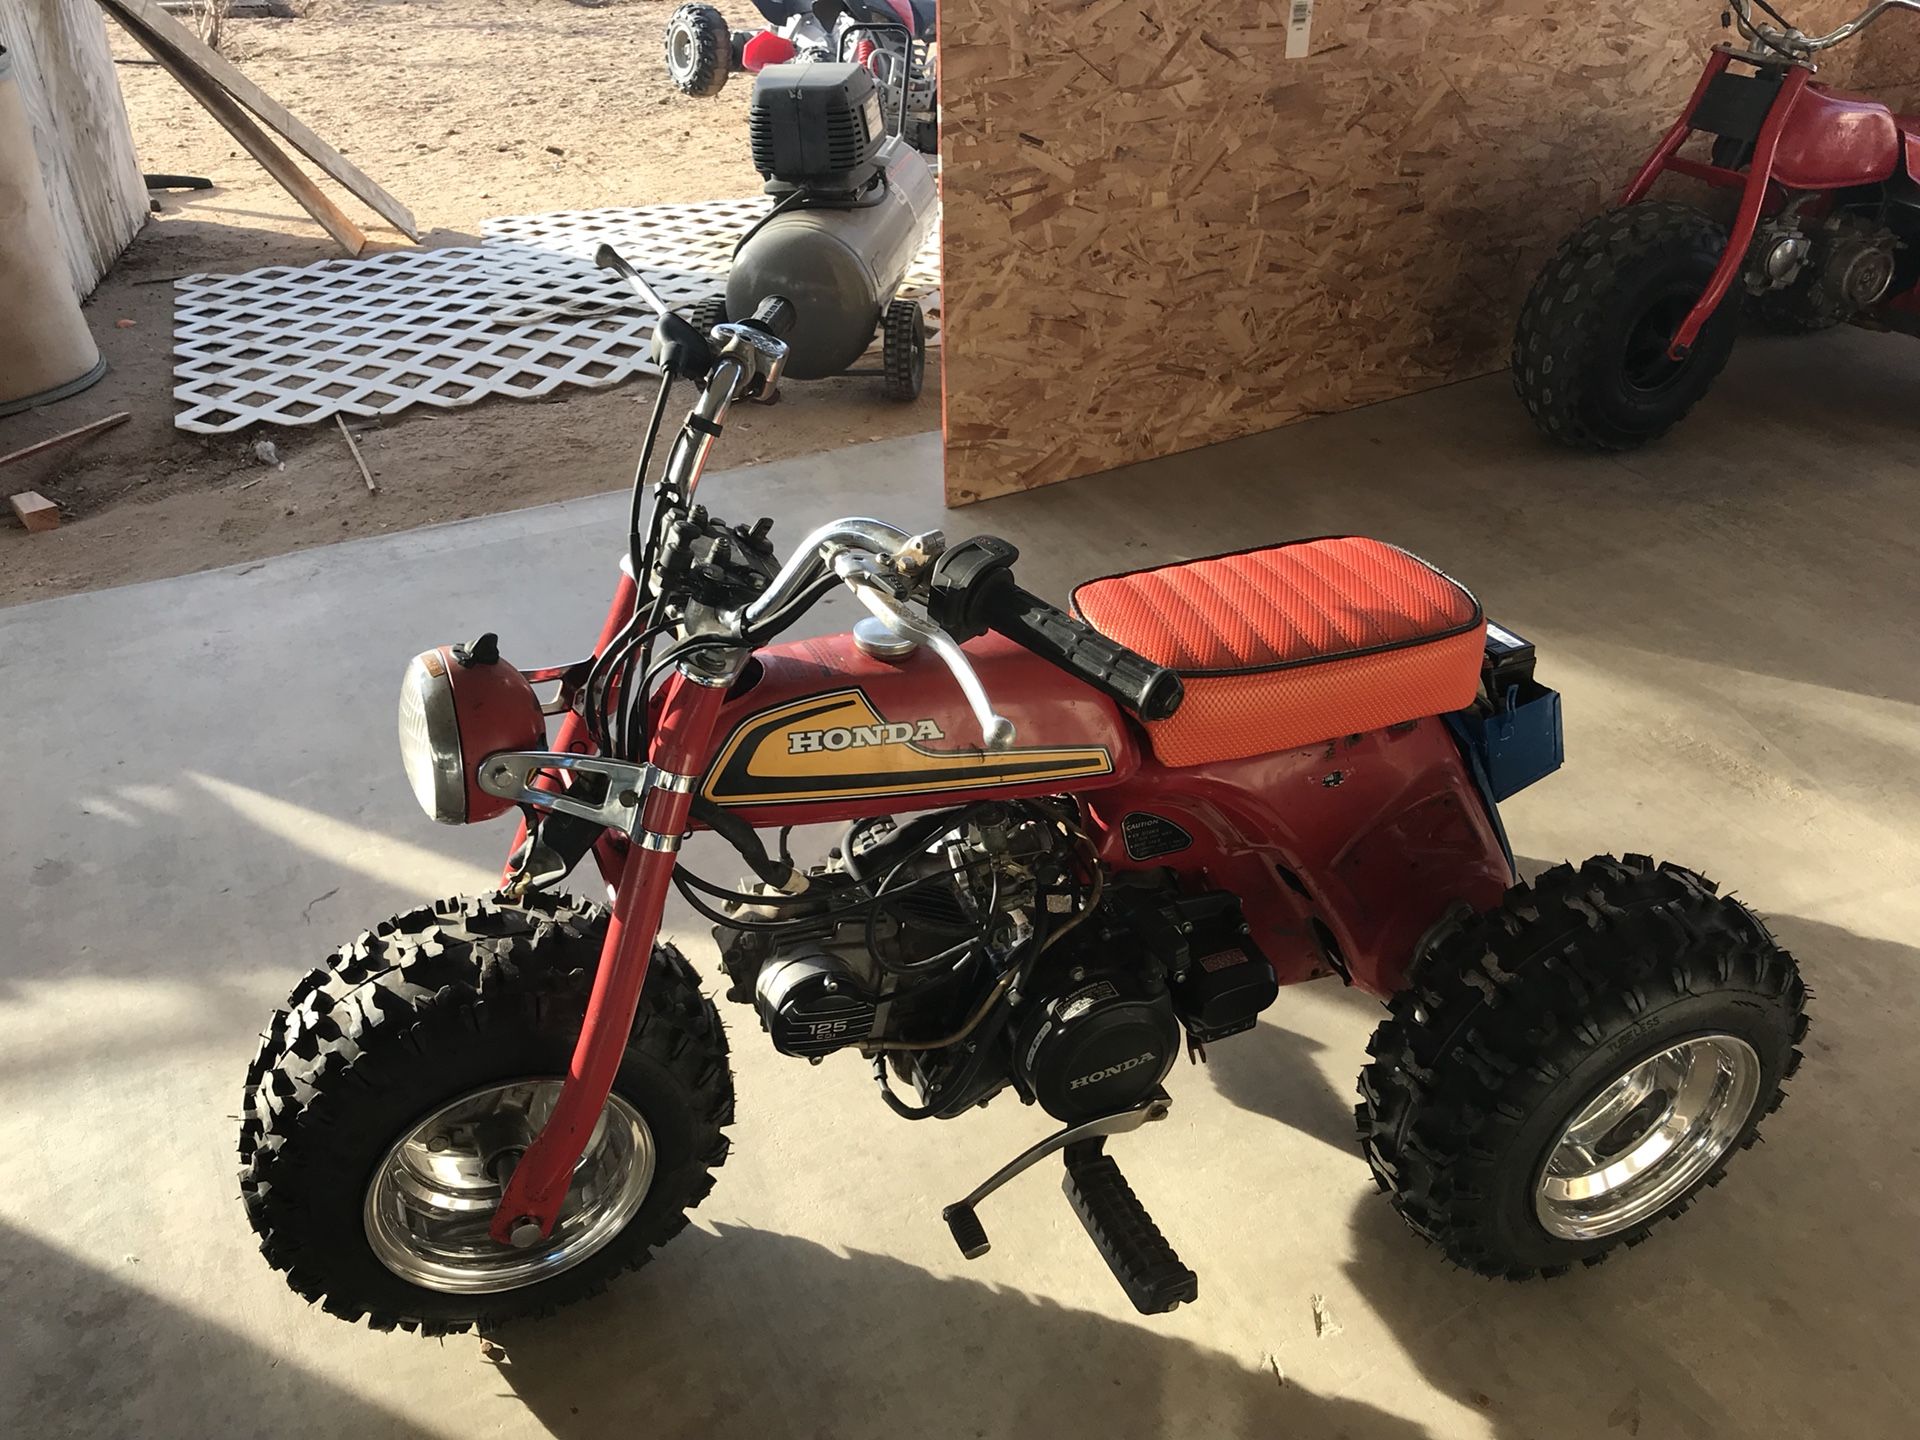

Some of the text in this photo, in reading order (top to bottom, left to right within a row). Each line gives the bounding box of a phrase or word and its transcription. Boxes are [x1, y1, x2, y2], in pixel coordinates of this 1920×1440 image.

[788, 719, 945, 755] HONDA
[1126, 819, 1160, 831] CAUTION
[808, 1020, 848, 1035] 125
[1606, 1016, 1661, 1053] TUBELESS
[1069, 1052, 1157, 1090] HONDA
